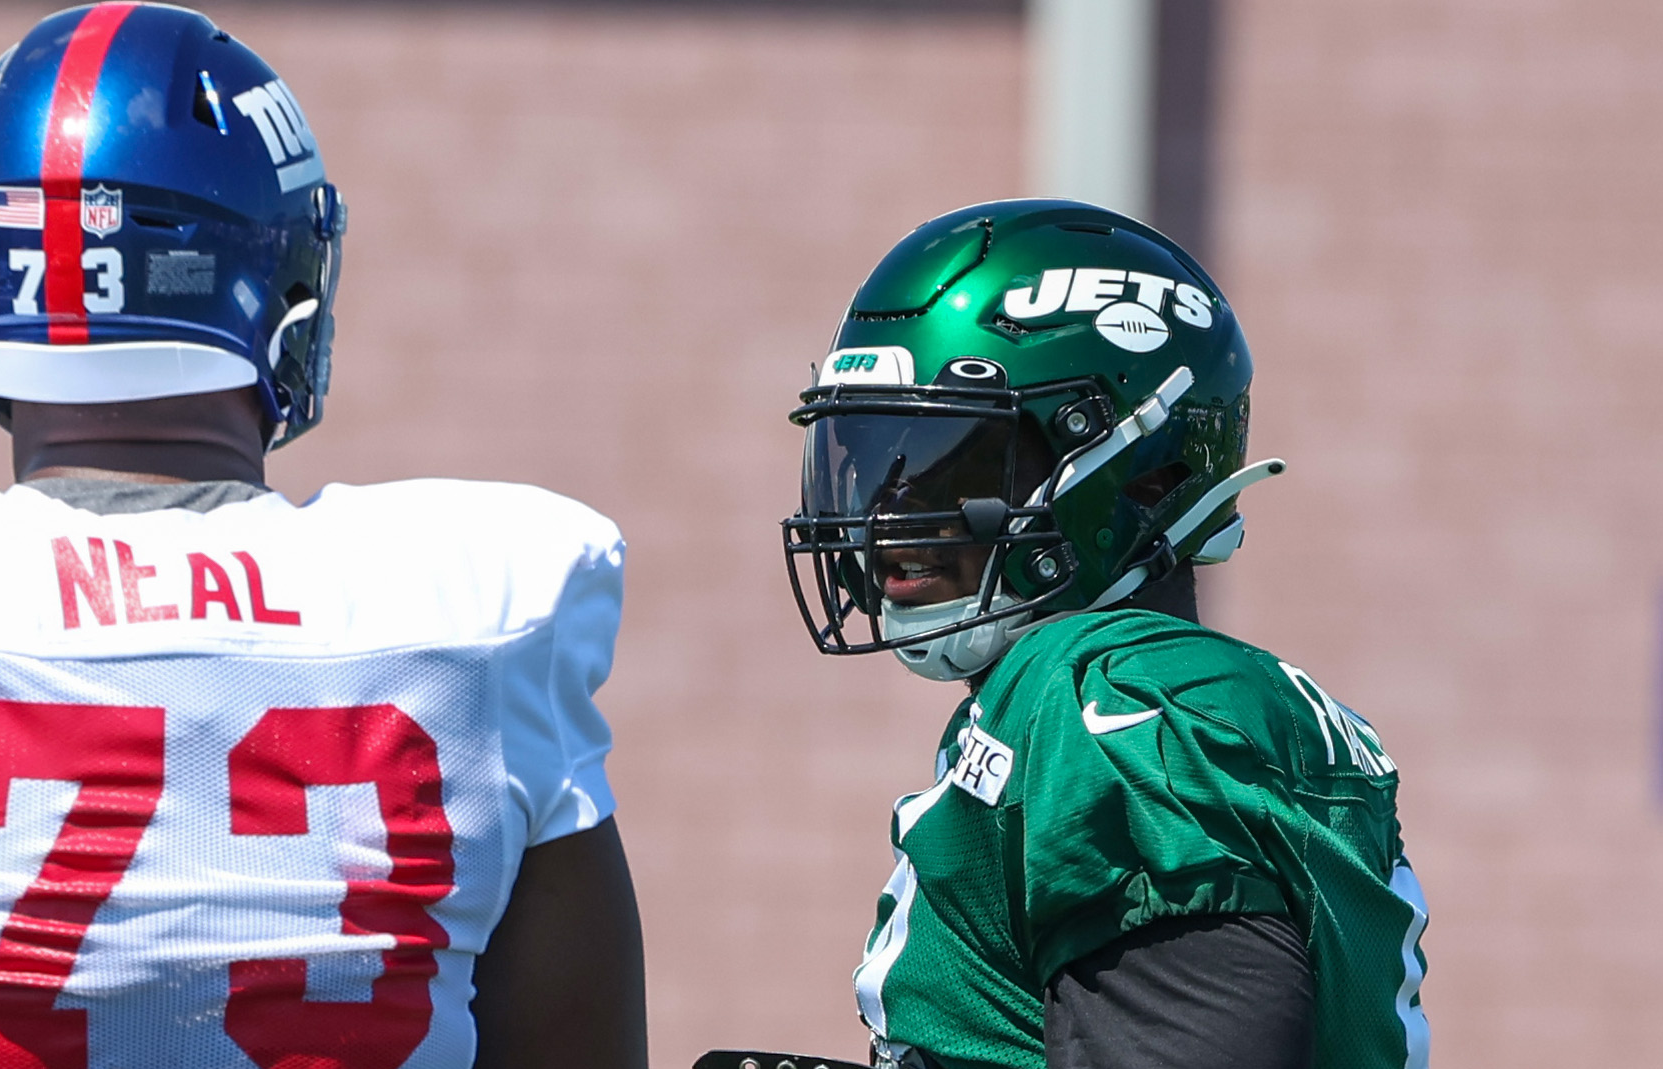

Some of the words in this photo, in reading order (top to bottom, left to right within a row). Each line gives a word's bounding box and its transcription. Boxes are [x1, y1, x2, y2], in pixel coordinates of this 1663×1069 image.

[88, 207, 116, 229] NFL
[1004, 268, 1213, 329] JETS
[833, 354, 878, 373] JETS
[51, 536, 301, 630] NEAL
